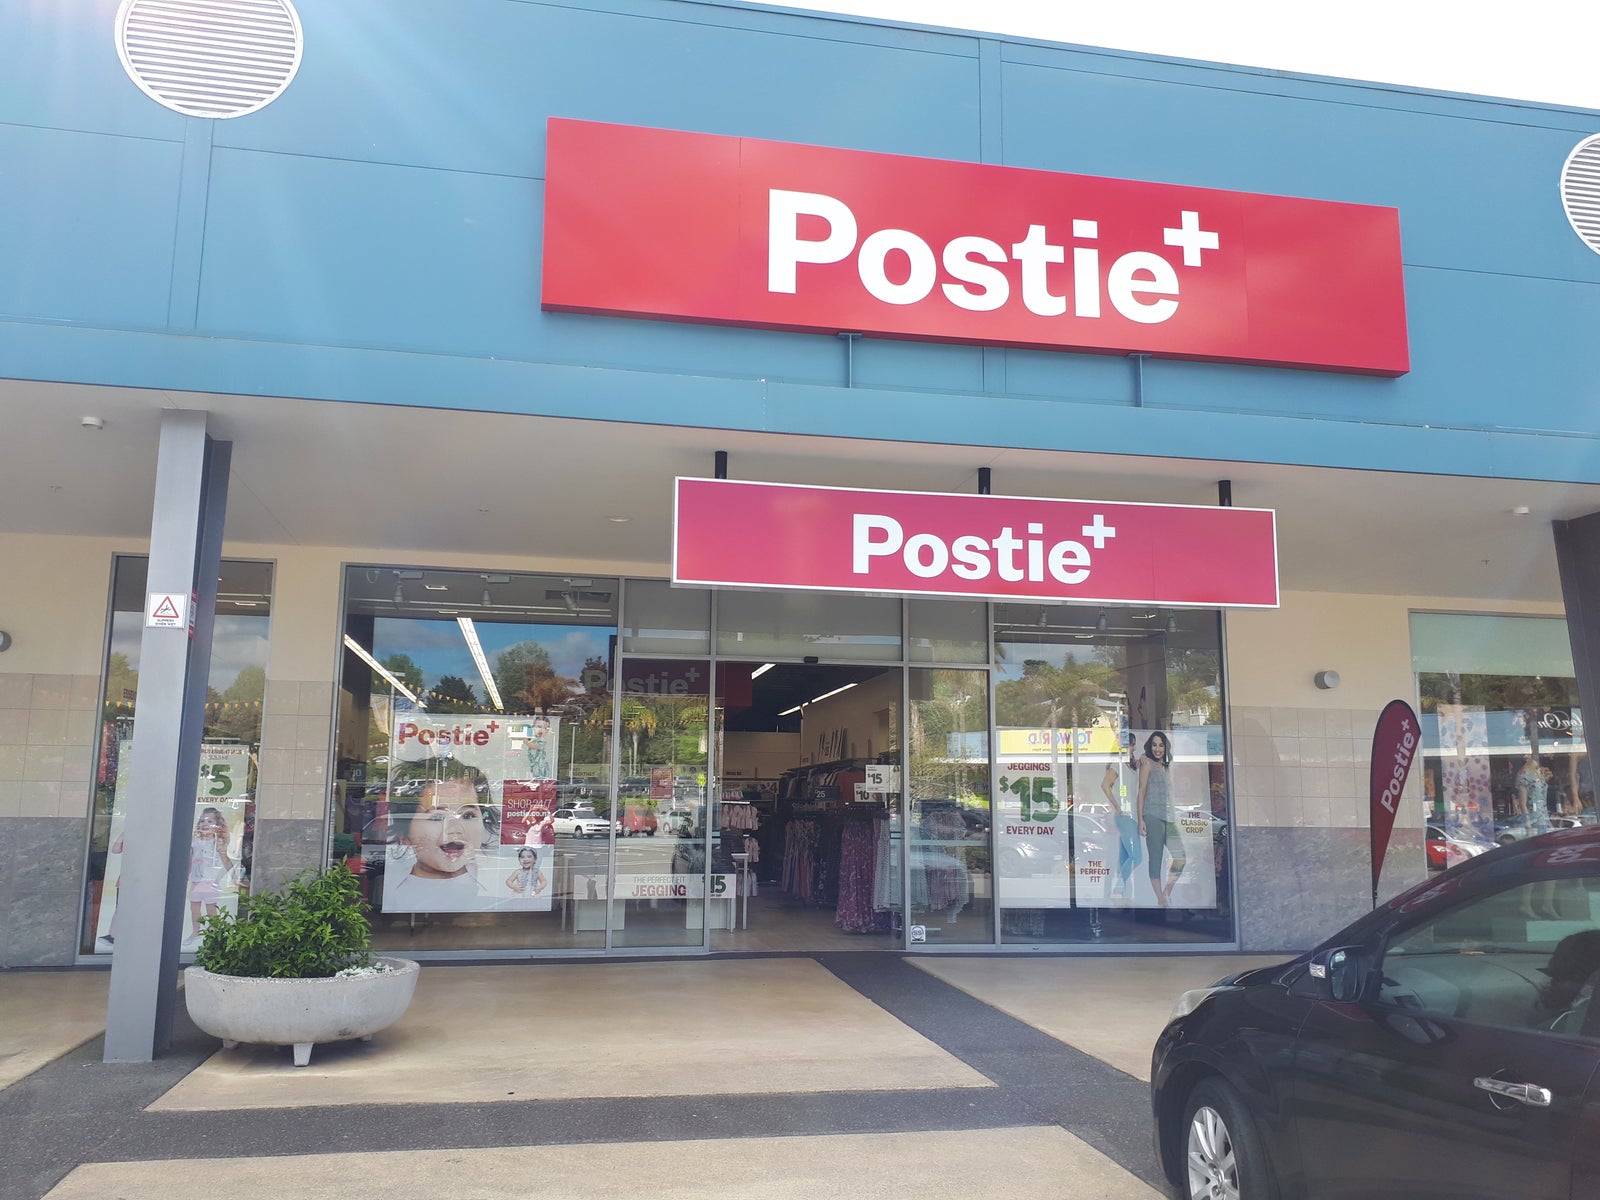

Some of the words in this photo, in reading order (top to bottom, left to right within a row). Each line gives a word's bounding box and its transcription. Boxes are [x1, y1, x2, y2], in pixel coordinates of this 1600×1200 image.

[1007, 762, 1050, 772] JEGGINGS
[201, 763, 232, 796] $5
[999, 775, 1060, 823] $15
[507, 799, 532, 809] SHOP
[1188, 811, 1201, 819] THE
[1180, 819, 1209, 827] CLASSIC
[1006, 825, 1035, 835] EVERY
[1037, 827, 1055, 836] DAY
[1185, 826, 1204, 834] CROP
[1088, 860, 1103, 868] THE
[1080, 868, 1111, 876] PERFECT
[633, 876, 647, 884] THE
[648, 876, 674, 884] PERFECT
[632, 884, 687, 897] JEGGING
